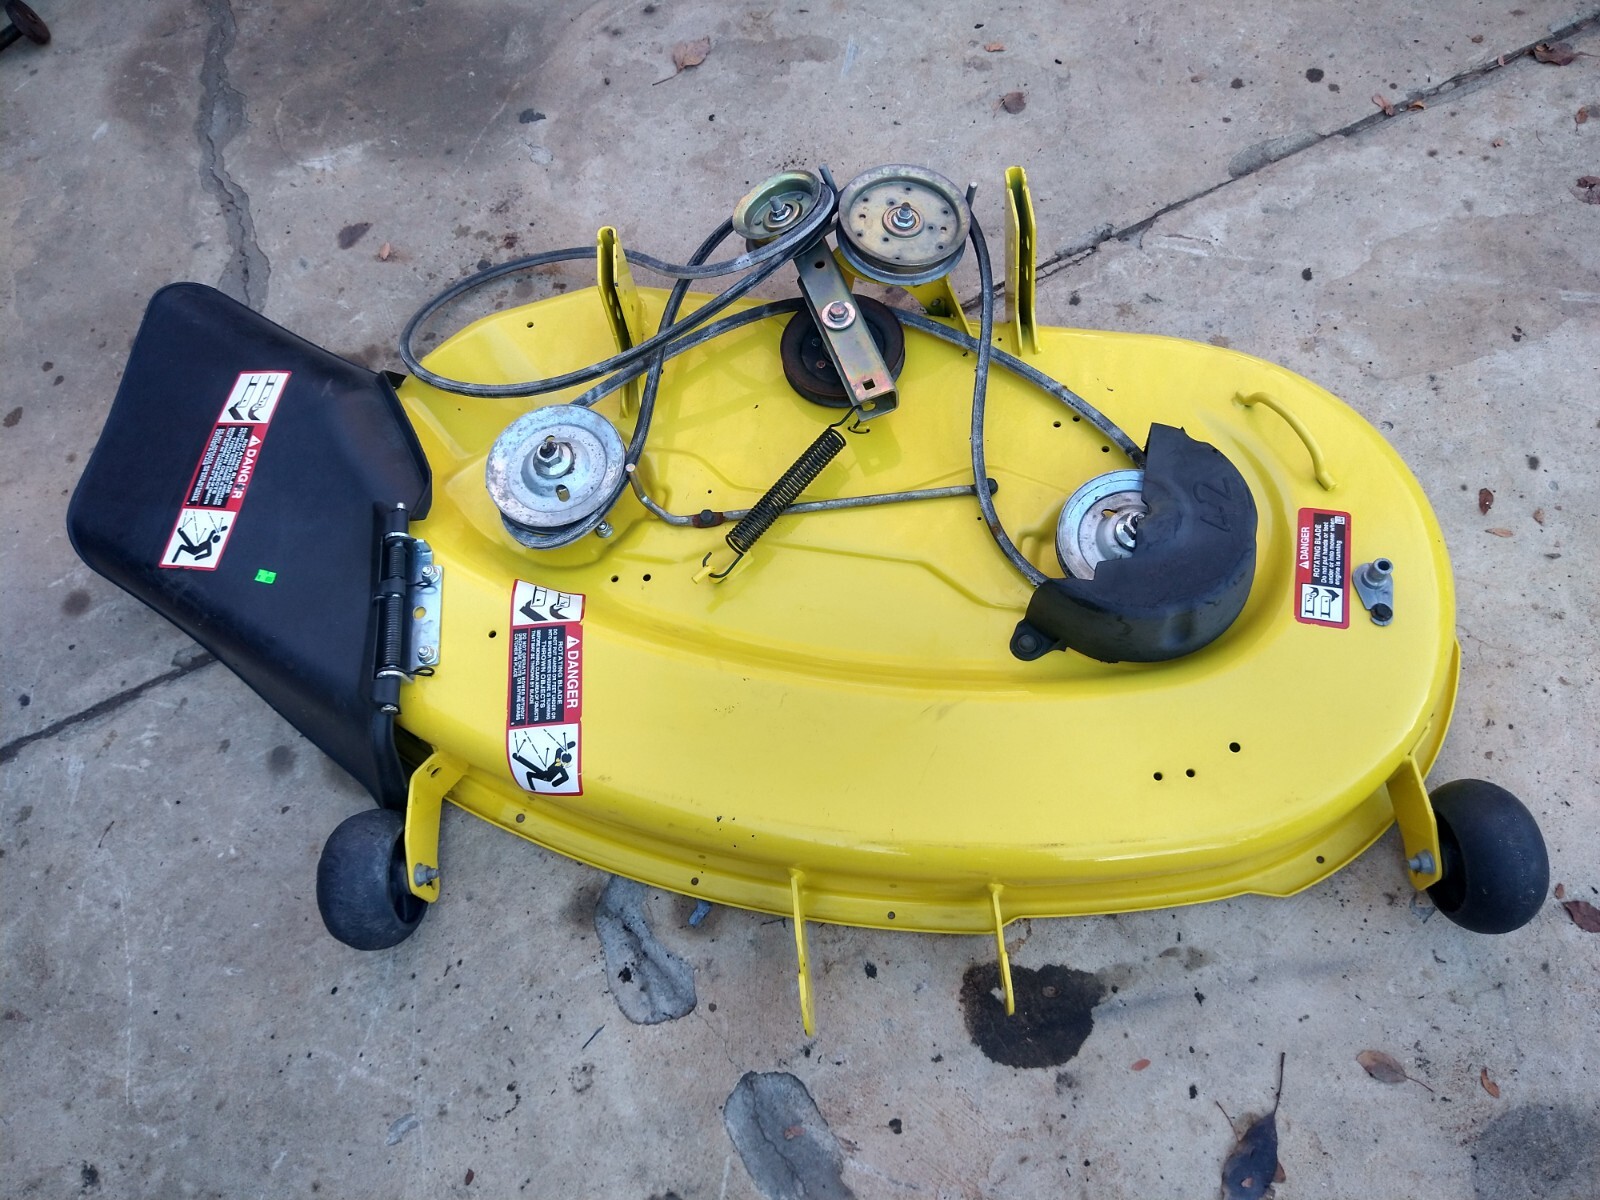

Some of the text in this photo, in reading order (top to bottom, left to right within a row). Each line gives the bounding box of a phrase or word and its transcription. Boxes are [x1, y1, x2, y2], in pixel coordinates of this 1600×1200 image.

[1300, 527, 1310, 560] DANGER
[1313, 546, 1321, 577] ROTATING
[566, 650, 579, 708] DANGER
